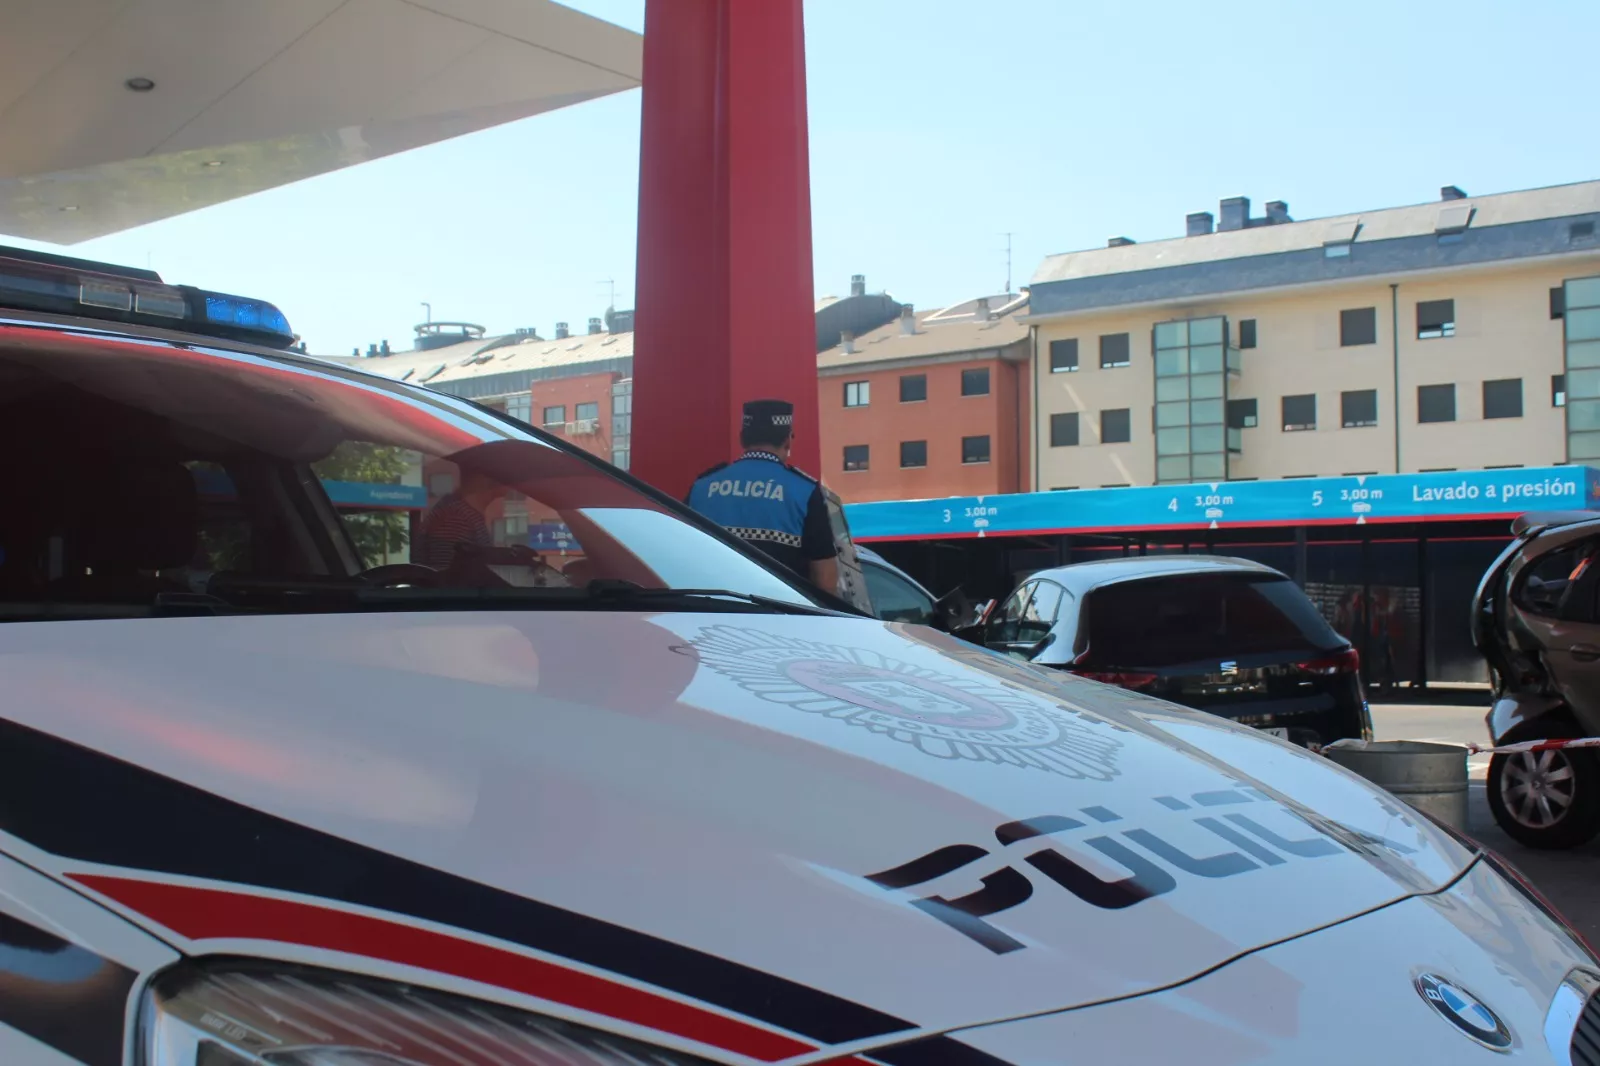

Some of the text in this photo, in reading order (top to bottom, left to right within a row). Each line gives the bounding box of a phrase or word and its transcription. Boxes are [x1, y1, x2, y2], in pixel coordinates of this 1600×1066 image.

[708, 479, 783, 501] POLICÍA
[1340, 489, 1383, 501] 3,00 m
[1412, 479, 1576, 502] Lavado a presión
[1168, 498, 1178, 512] 4
[1195, 495, 1234, 507] 3,00 m
[1312, 490, 1323, 506] 5
[943, 509, 951, 523] 3
